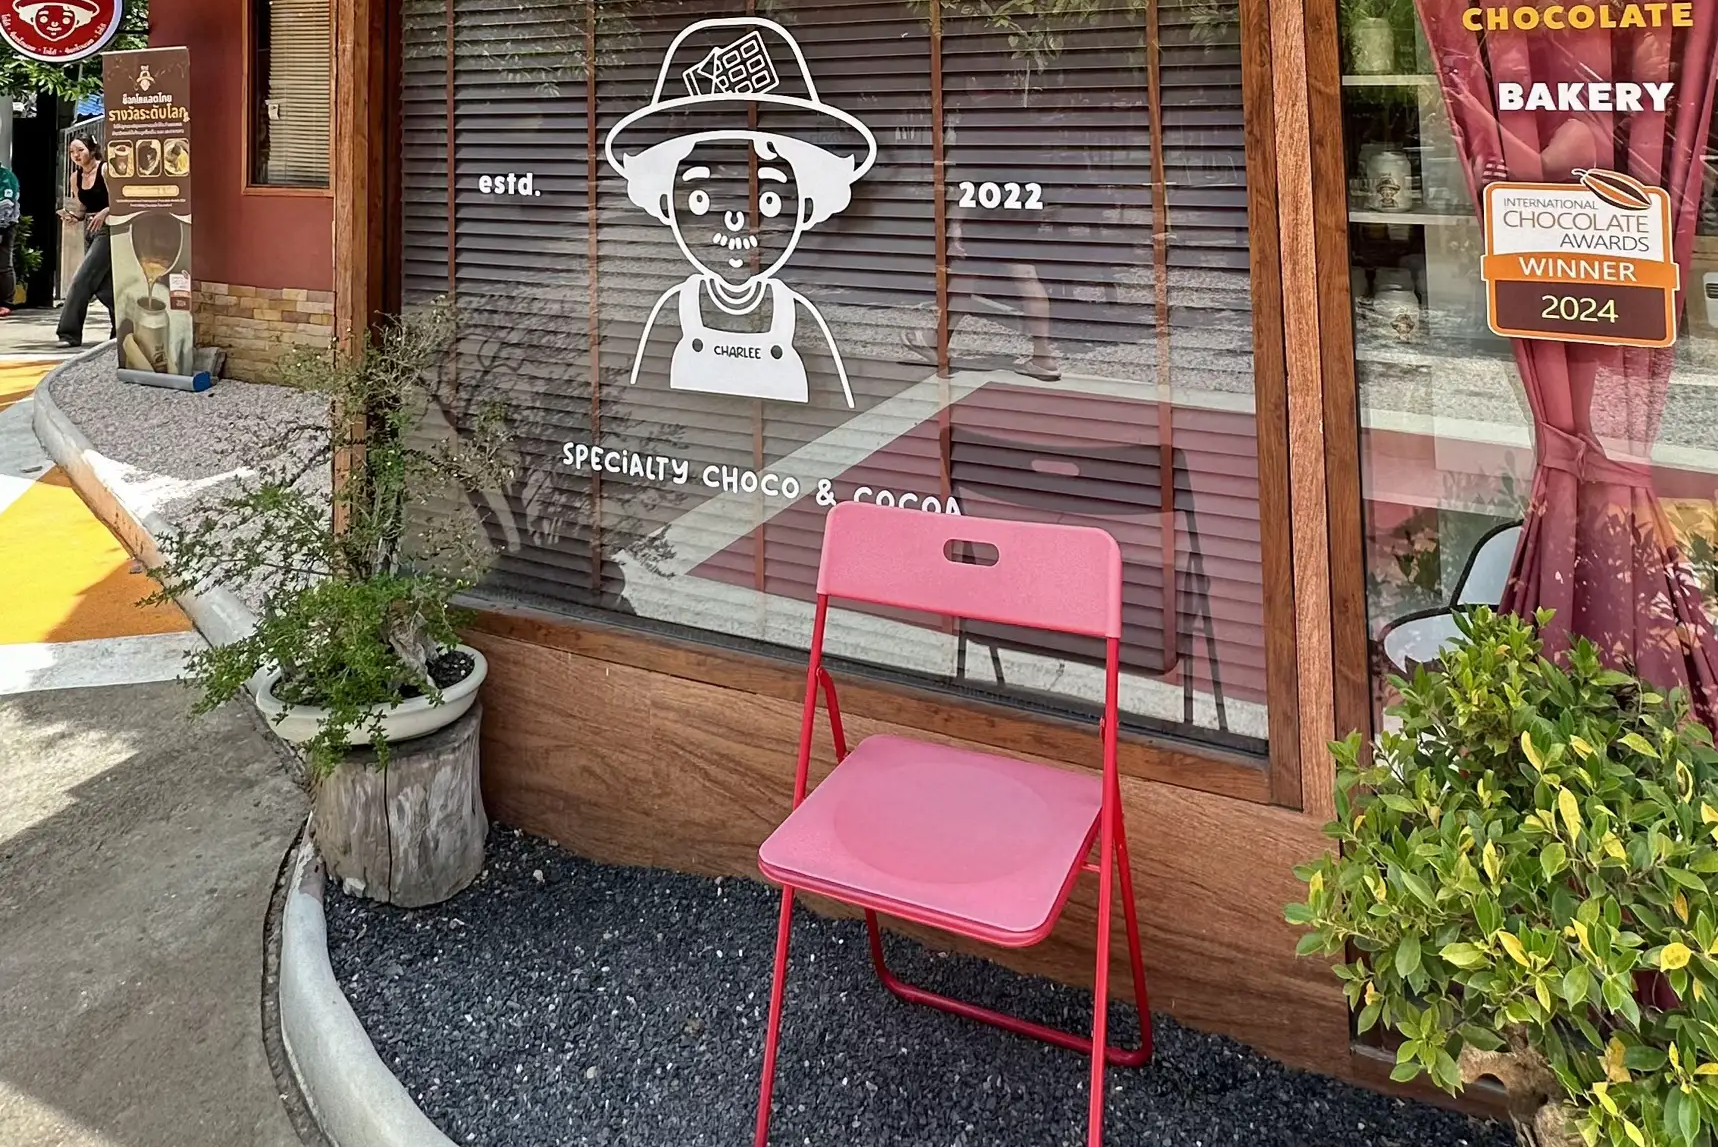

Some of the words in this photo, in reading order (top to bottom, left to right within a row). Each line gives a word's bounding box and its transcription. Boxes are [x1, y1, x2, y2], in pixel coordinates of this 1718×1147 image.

[1462, 2, 1694, 31] CHOCOLATE
[1498, 82, 1675, 112] BAKERY
[478, 172, 542, 198] estd.
[958, 181, 1044, 211] 2022
[1503, 197, 1599, 210] INTERNATIONAL
[1503, 210, 1649, 234] CHOCOLATE
[1560, 233, 1650, 252] AWARDS
[1518, 256, 1637, 282] WINNER
[1541, 294, 1619, 324] 2024
[713, 345, 762, 359] CHARLEE
[702, 465, 800, 500] CHOCO
[815, 478, 837, 507] &
